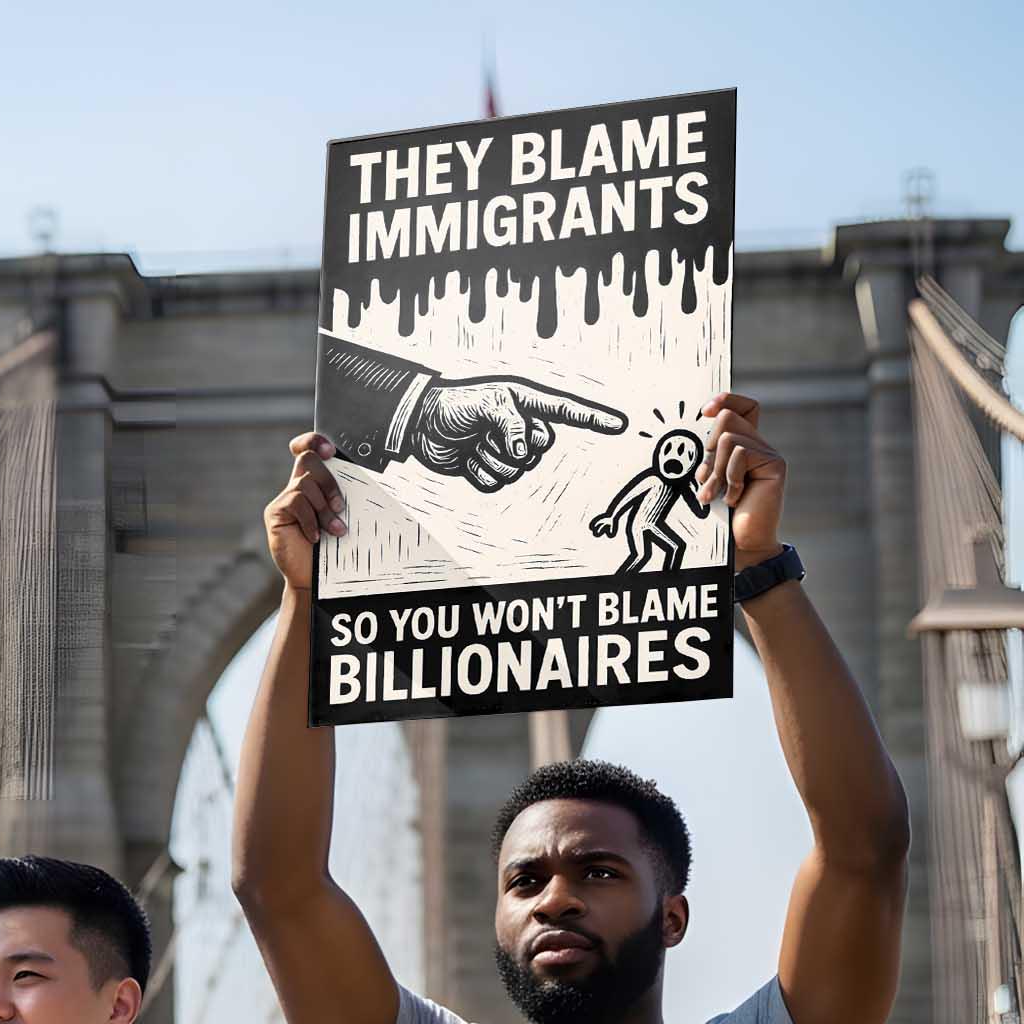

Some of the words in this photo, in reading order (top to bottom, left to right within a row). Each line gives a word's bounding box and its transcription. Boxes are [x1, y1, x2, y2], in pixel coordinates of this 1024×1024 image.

[349, 136, 495, 204] THEY
[510, 110, 707, 186] BLAME
[347, 171, 709, 264] IMMIGRANTS
[330, 611, 378, 647] SO
[388, 604, 460, 642] YOU
[471, 594, 587, 636] WON’T
[598, 583, 718, 627] BLAME
[329, 626, 711, 705] BILLIONAIRES
